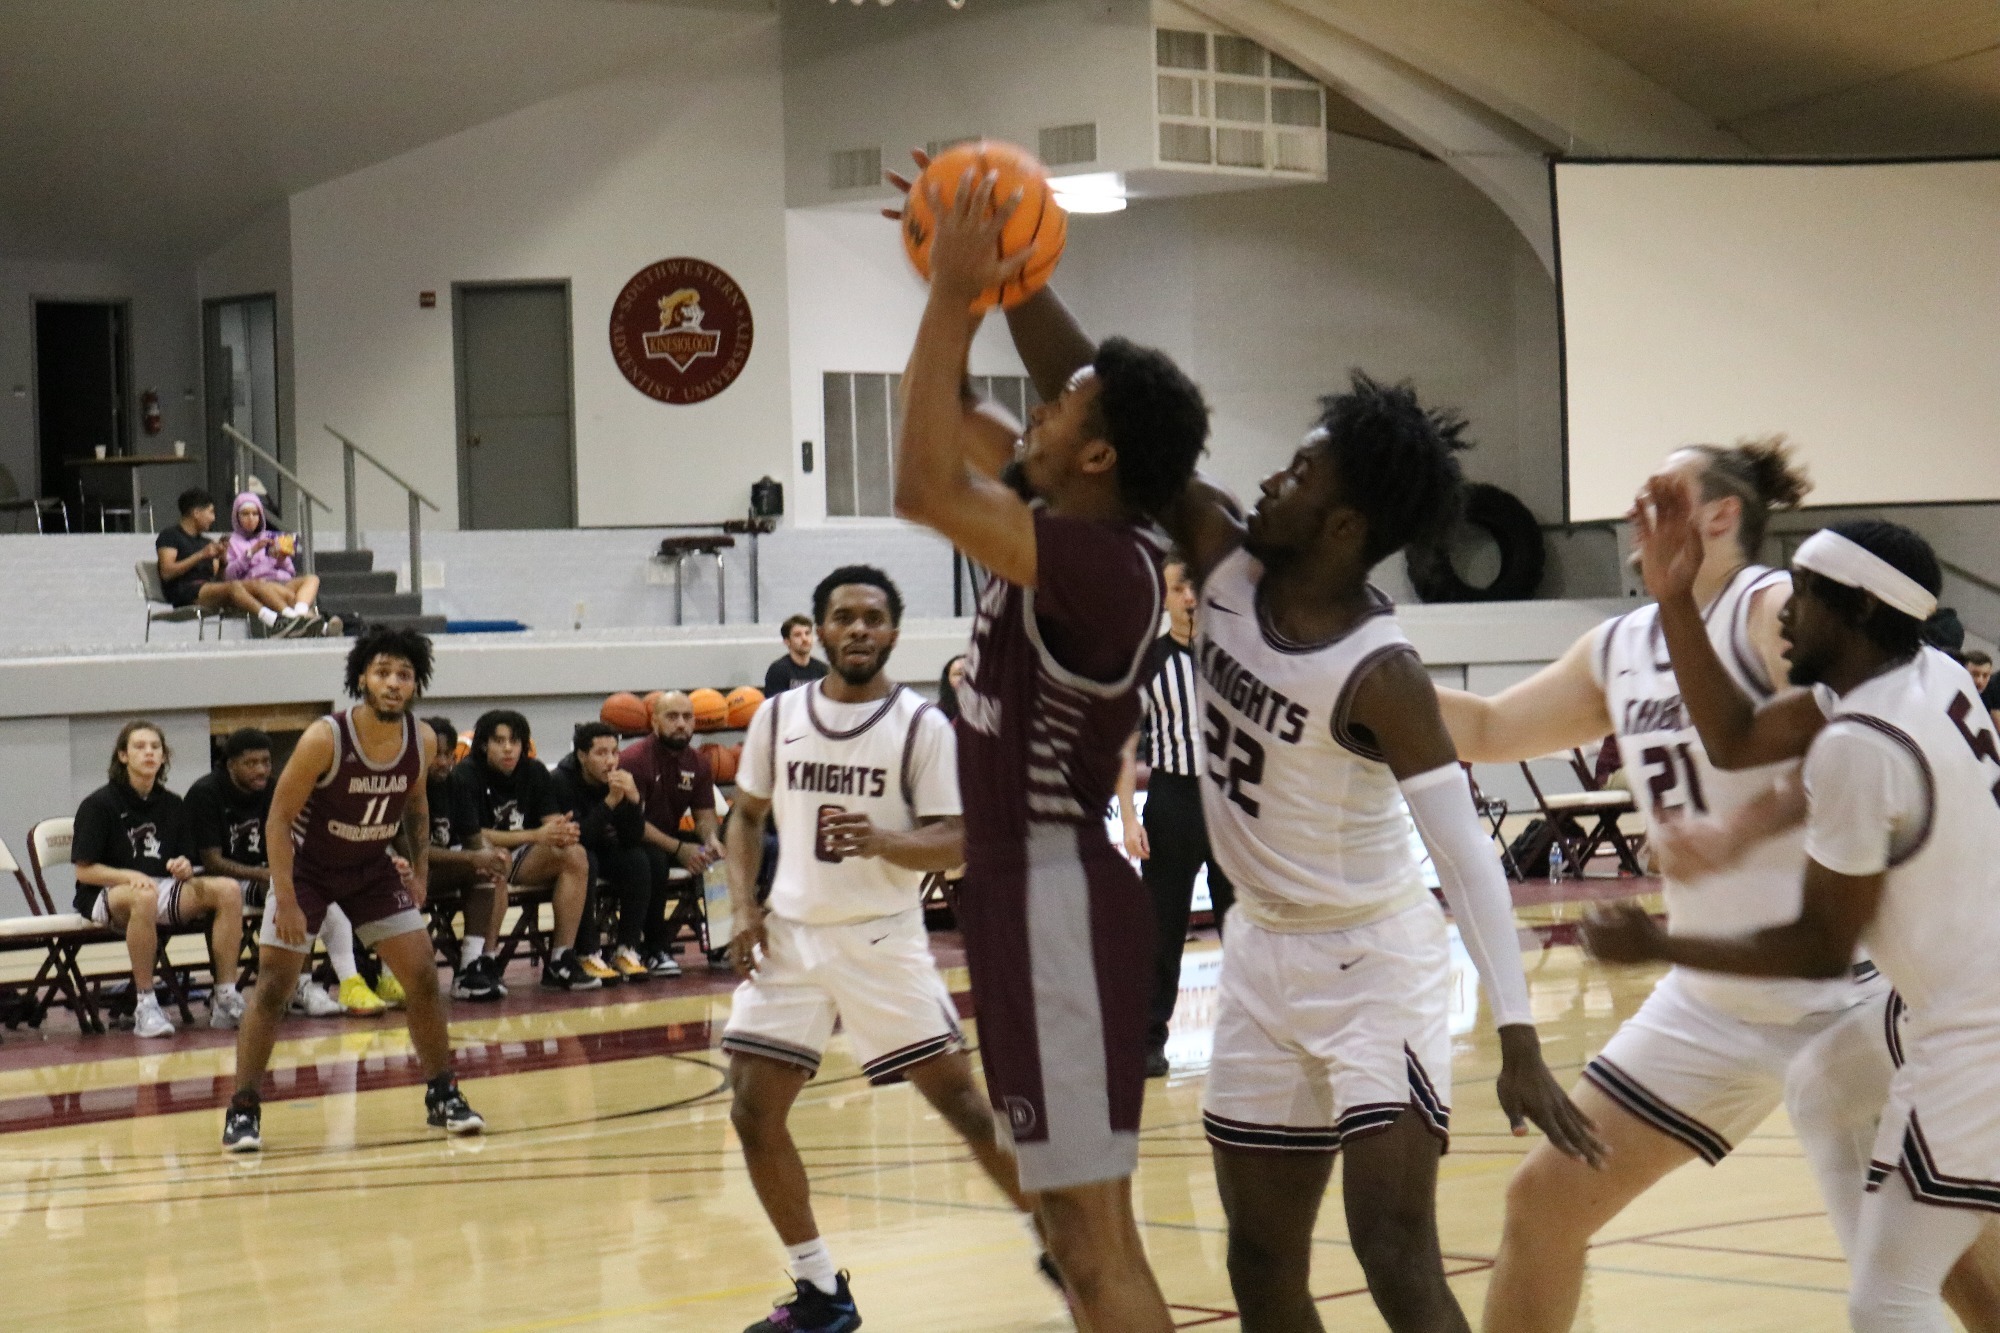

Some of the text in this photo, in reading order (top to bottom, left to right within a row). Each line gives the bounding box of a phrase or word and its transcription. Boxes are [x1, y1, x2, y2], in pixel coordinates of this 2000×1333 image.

[619, 260, 740, 312] SOUTHWESTERN
[612, 321, 749, 401] ADVENTIST UNIVERSITY
[650, 335, 713, 353] KINESIOLOGY
[787, 761, 888, 797] KNIGHTS
[1204, 701, 1265, 819] 22
[1642, 741, 1709, 823] 21
[348, 774, 408, 794] DALLAS
[359, 795, 391, 826] 11
